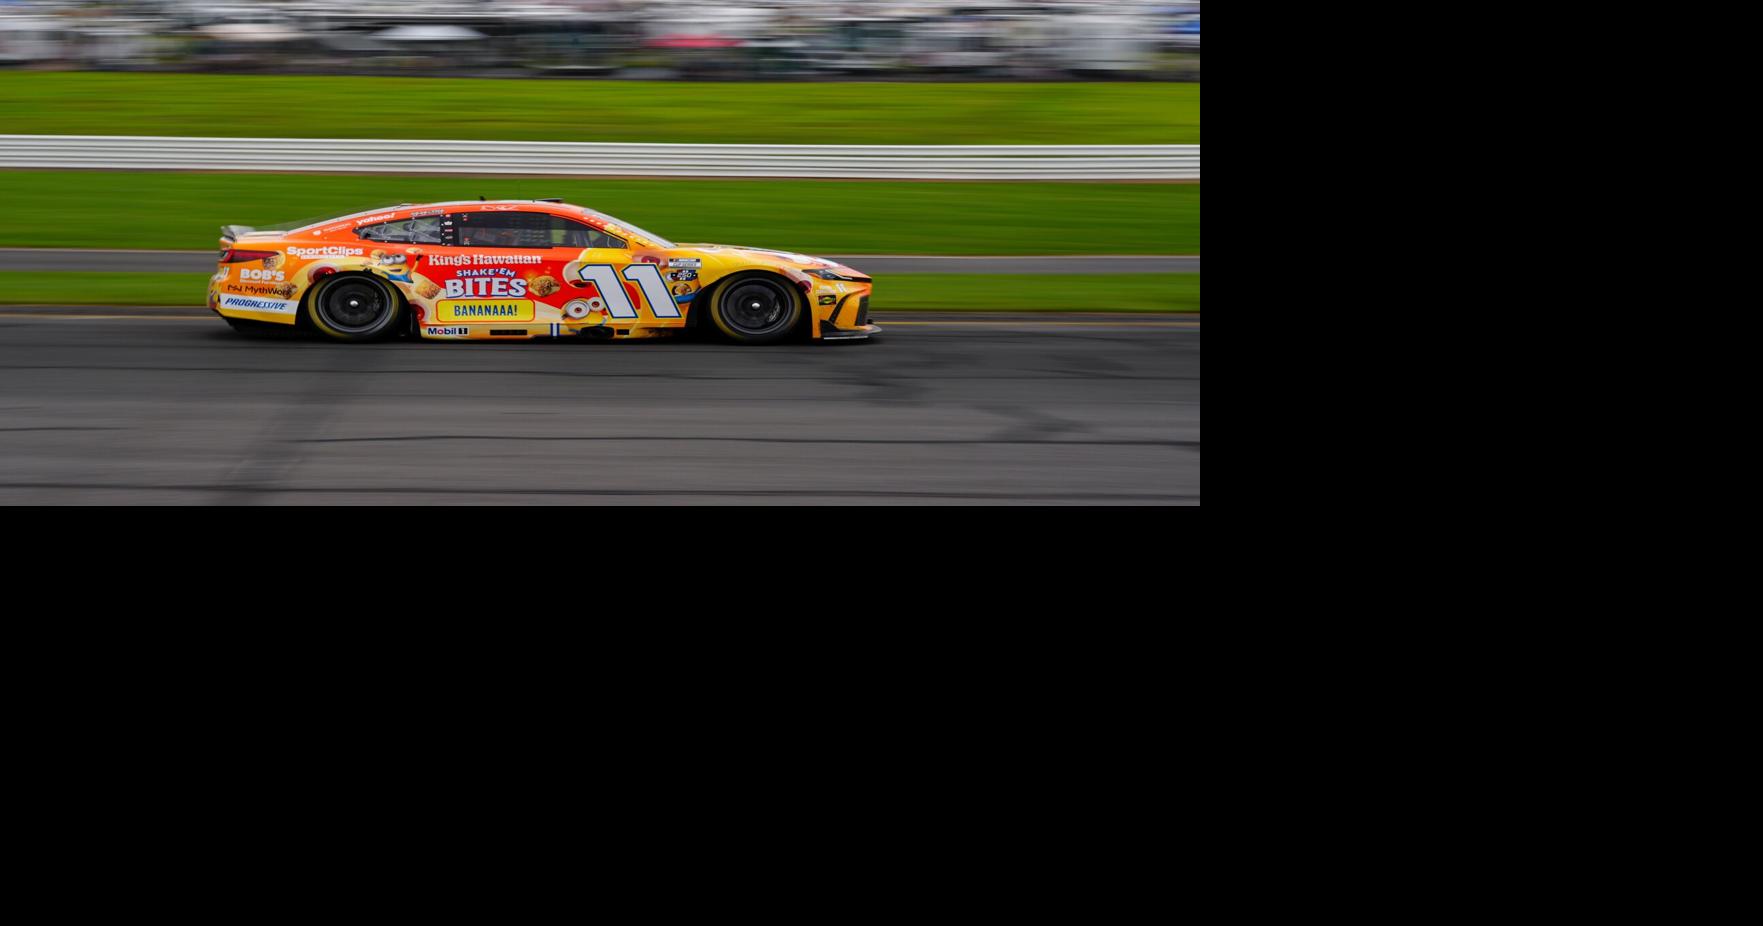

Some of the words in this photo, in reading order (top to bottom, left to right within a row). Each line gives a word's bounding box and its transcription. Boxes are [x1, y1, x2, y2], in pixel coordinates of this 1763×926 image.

[356, 213, 395, 225] yahoo!
[428, 254, 471, 266] King's
[473, 255, 543, 264] Hawaiian
[444, 277, 528, 298] BITES
[578, 263, 682, 318] 11
[225, 297, 287, 310] PROGRESSIVE
[454, 304, 518, 316] BANANAAA!
[427, 327, 457, 335] Mobil
